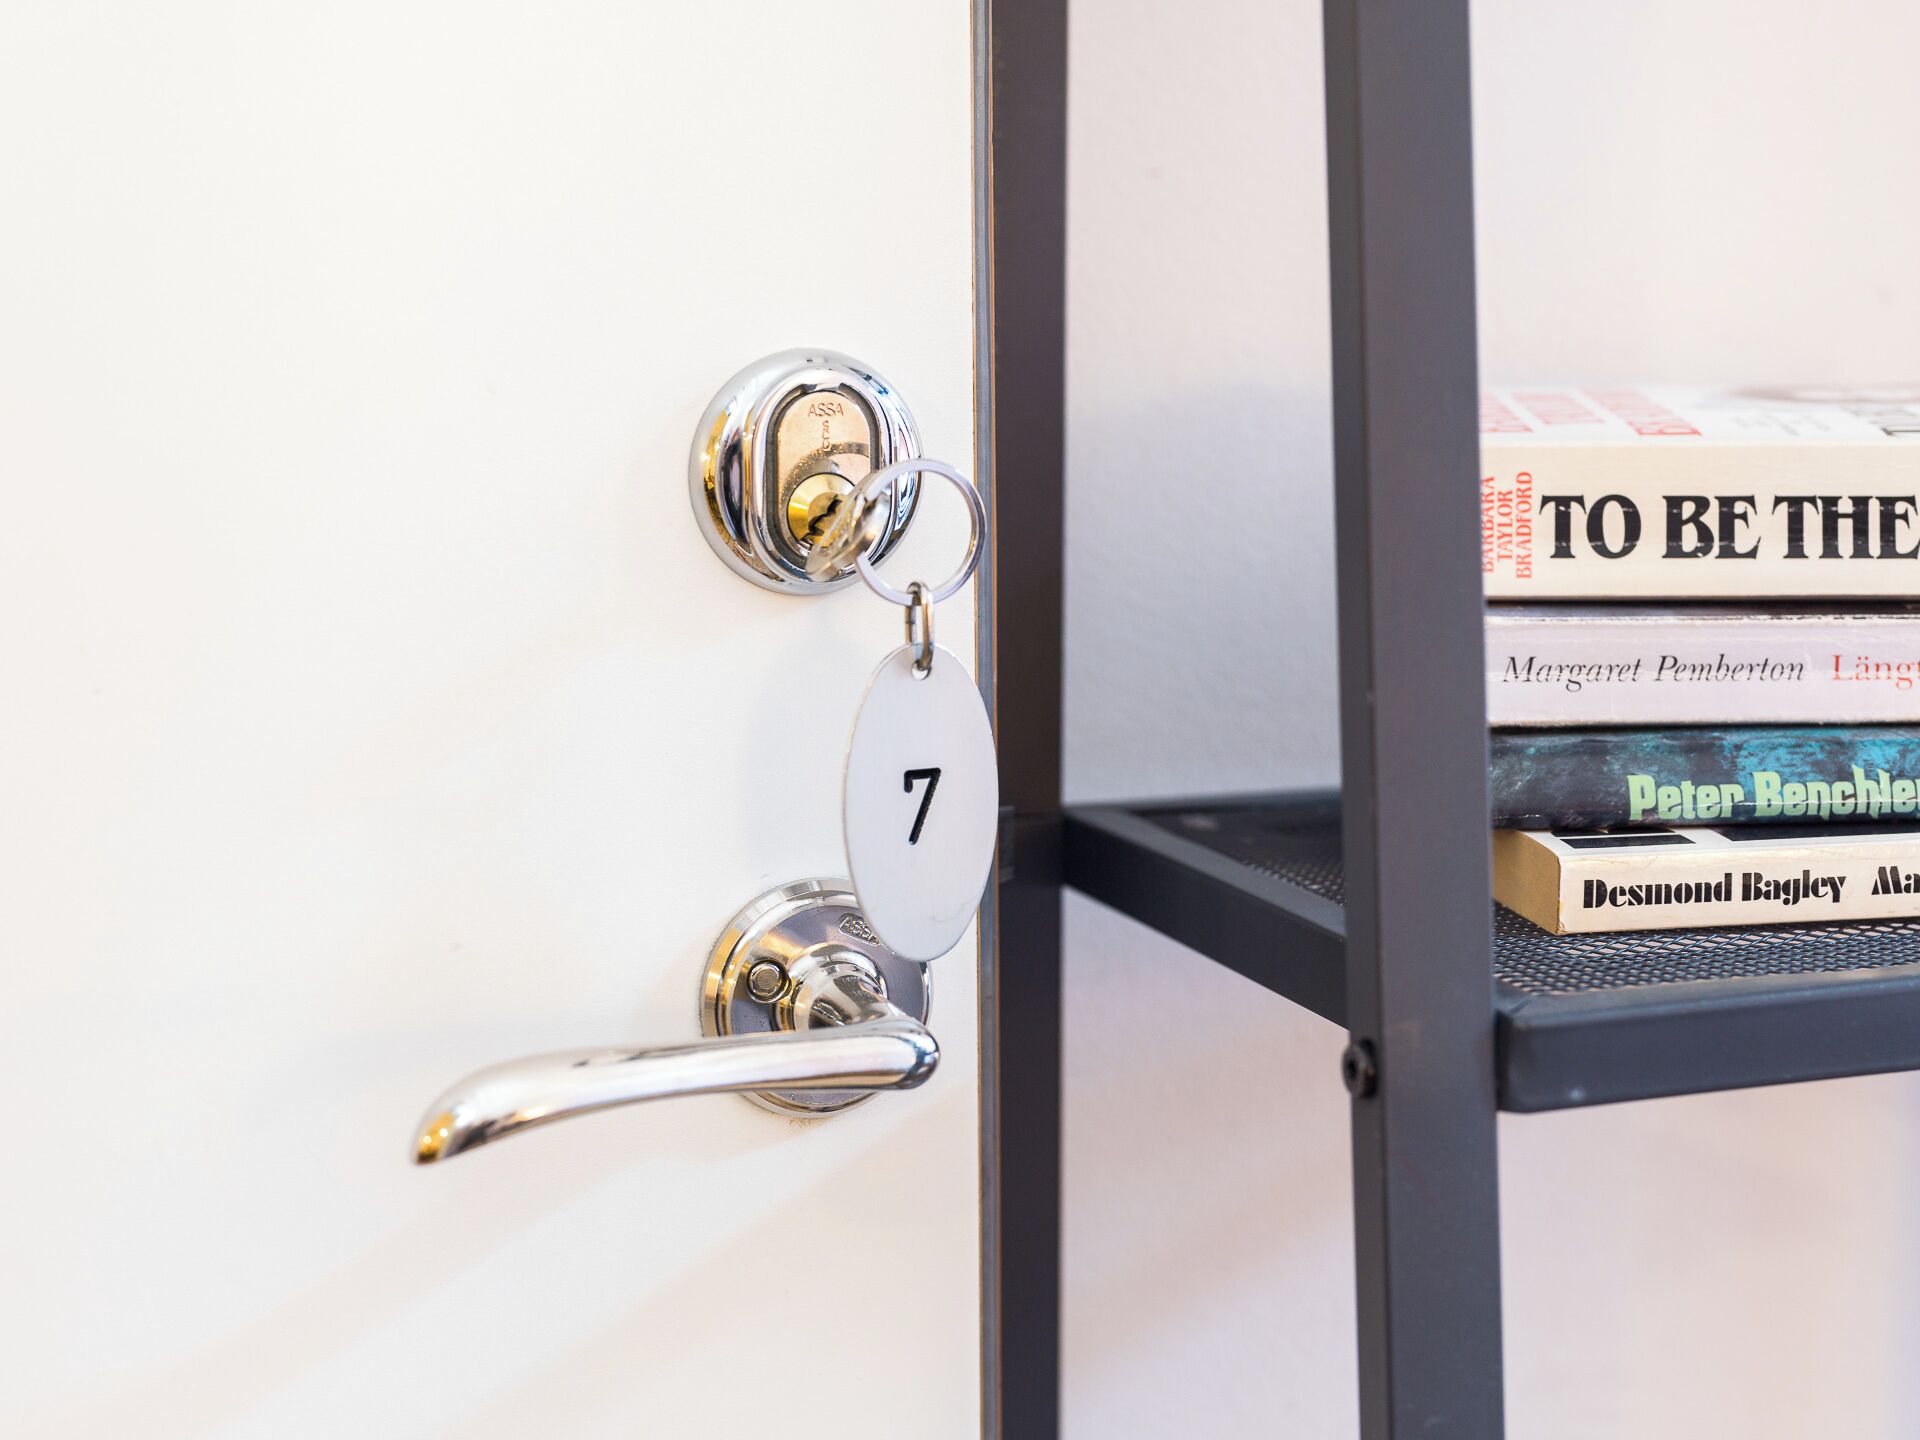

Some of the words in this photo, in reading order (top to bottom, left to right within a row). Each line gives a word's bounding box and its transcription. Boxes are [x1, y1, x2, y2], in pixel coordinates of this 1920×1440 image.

[808, 402, 844, 417] ASSA
[1481, 476, 1495, 573] BARBARA
[1497, 490, 1513, 562] TAYLOR
[1515, 471, 1533, 579] BRADFORD
[1539, 494, 1642, 560] TO
[1661, 494, 1762, 560] BE
[1771, 494, 1920, 560] THE
[1502, 655, 1641, 693] Margaret
[1653, 653, 1805, 682] Pemberton
[903, 767, 942, 846] 7
[1627, 774, 1745, 821] Peter
[1583, 872, 1733, 909] Desmond
[1741, 869, 1847, 906] Bagley
